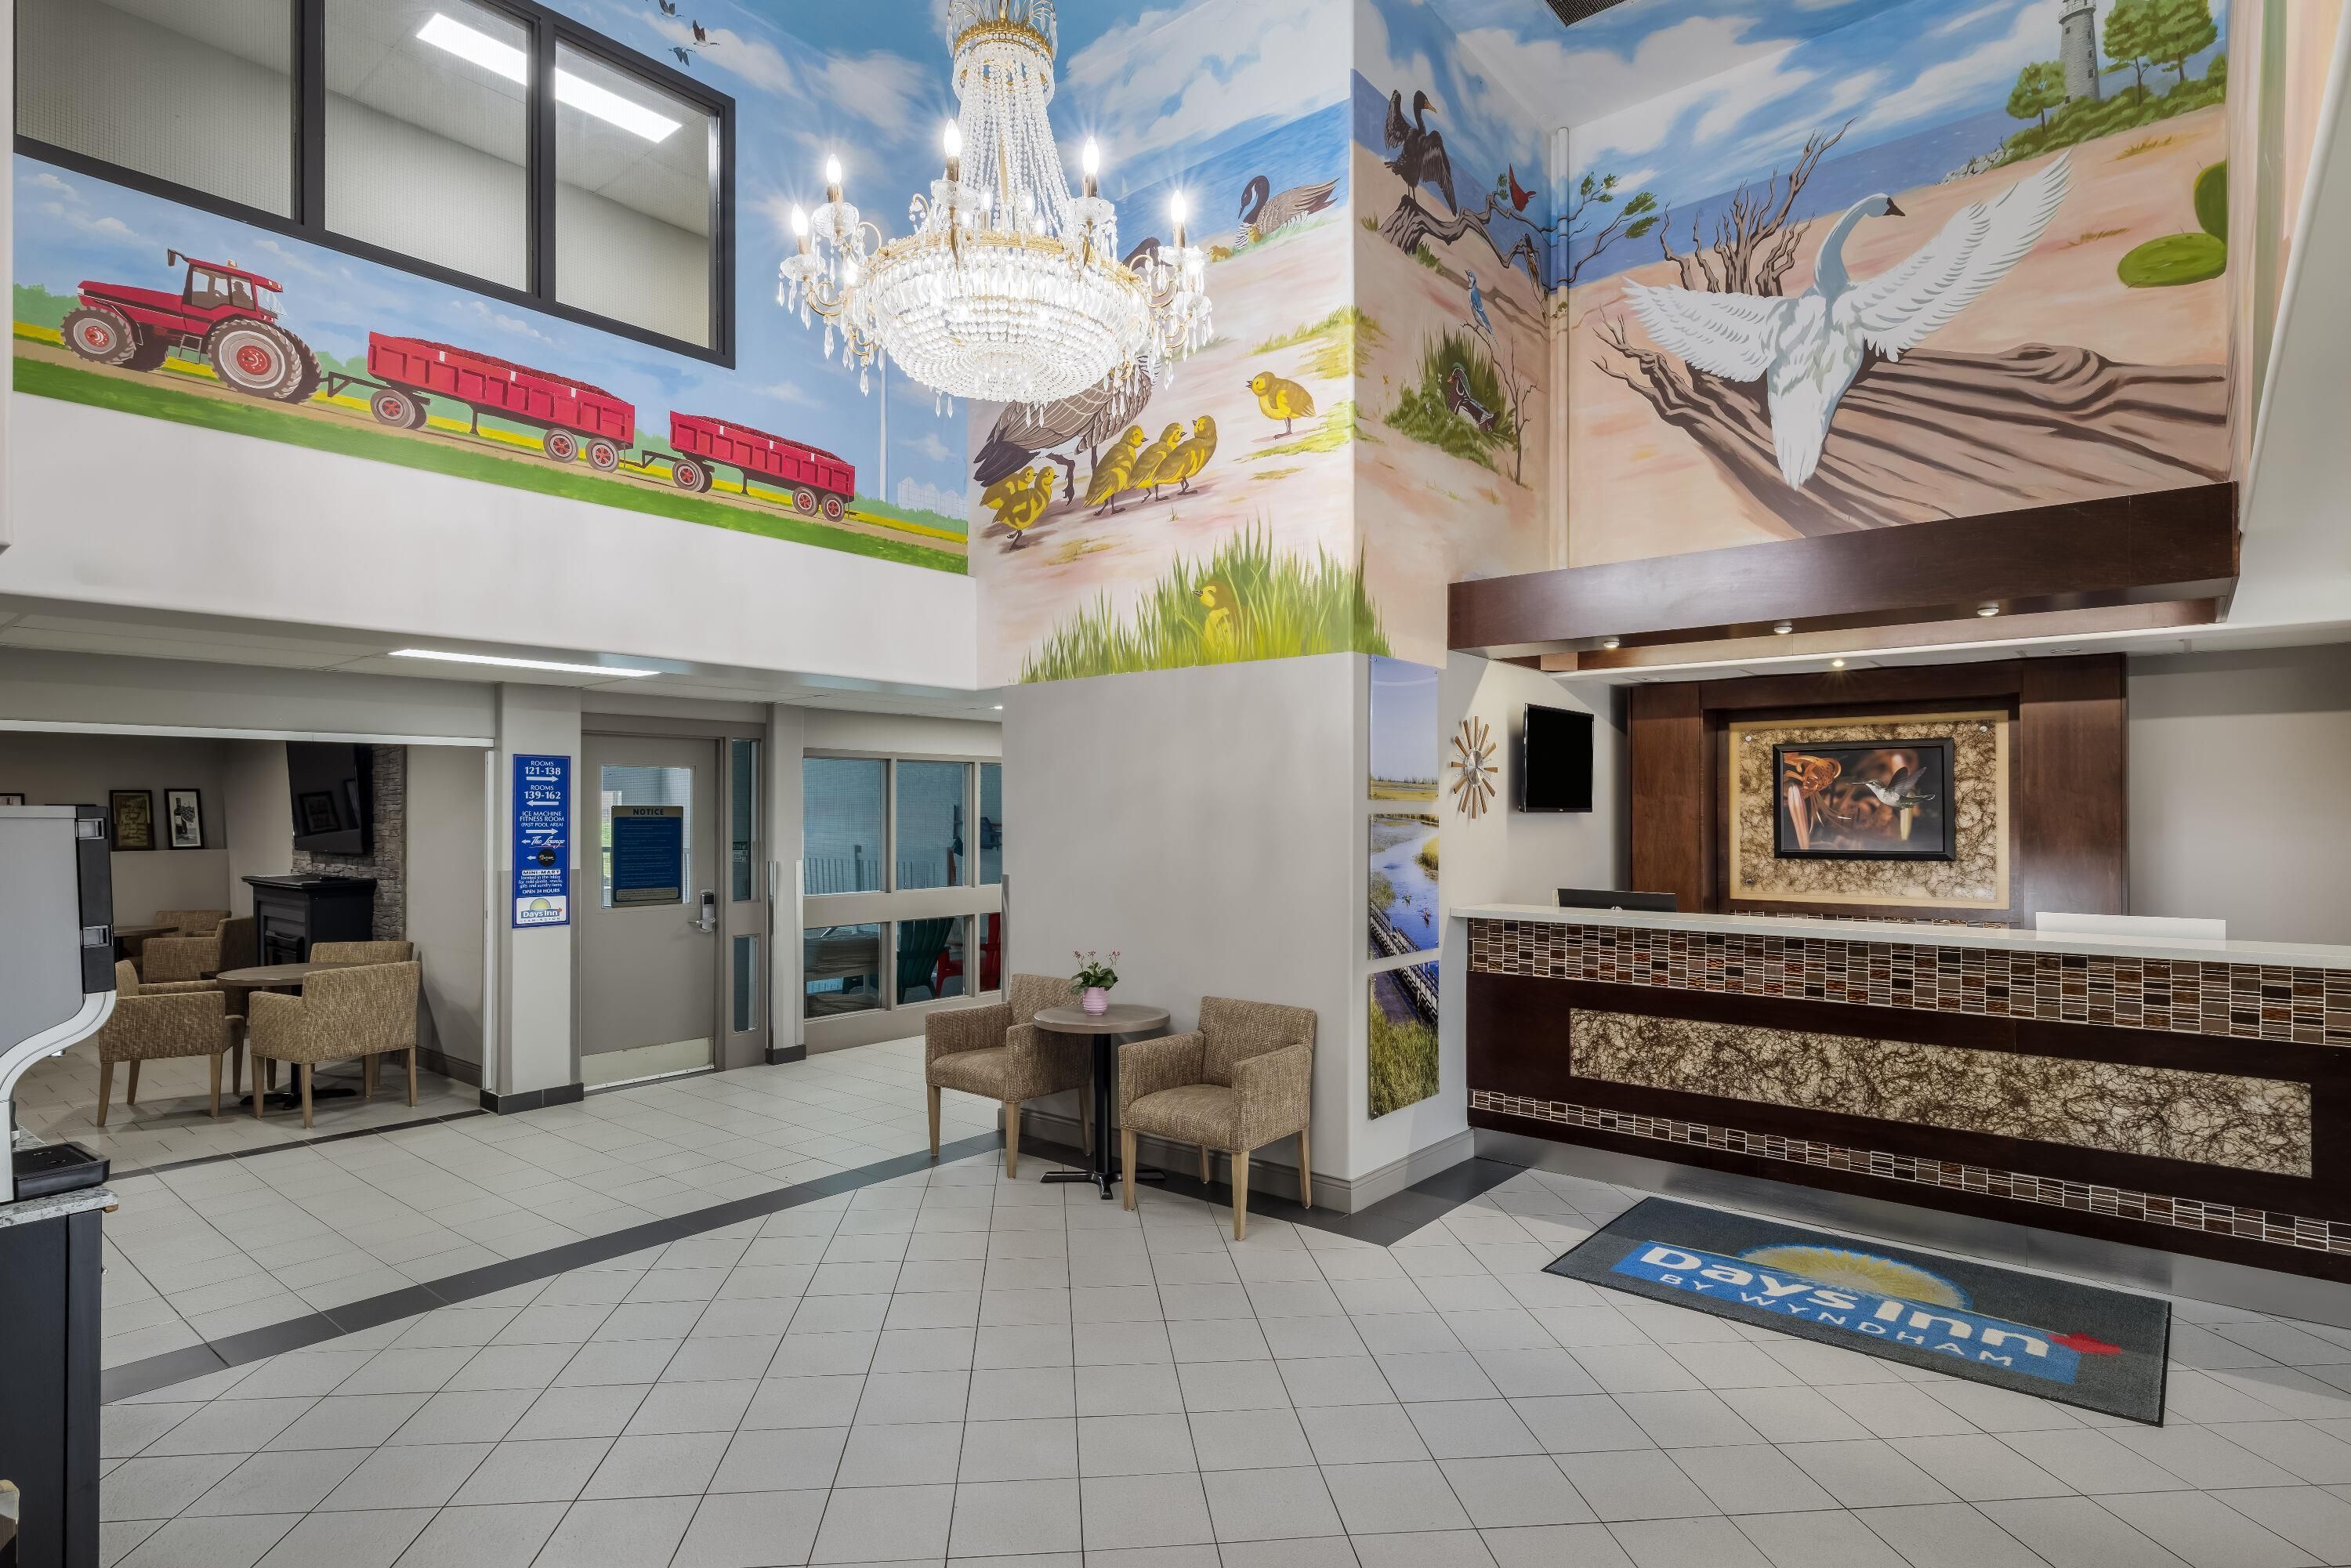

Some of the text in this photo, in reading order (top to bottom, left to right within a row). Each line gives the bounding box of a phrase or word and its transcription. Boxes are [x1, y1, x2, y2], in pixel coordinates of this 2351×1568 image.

[525, 766, 561, 775] 121-138
[524, 791, 561, 799] 139-162
[531, 835, 565, 849] The Lounge
[1640, 1246, 2049, 1357] Days Inn
[1659, 1273, 2013, 1367] BY WYNDHAM
